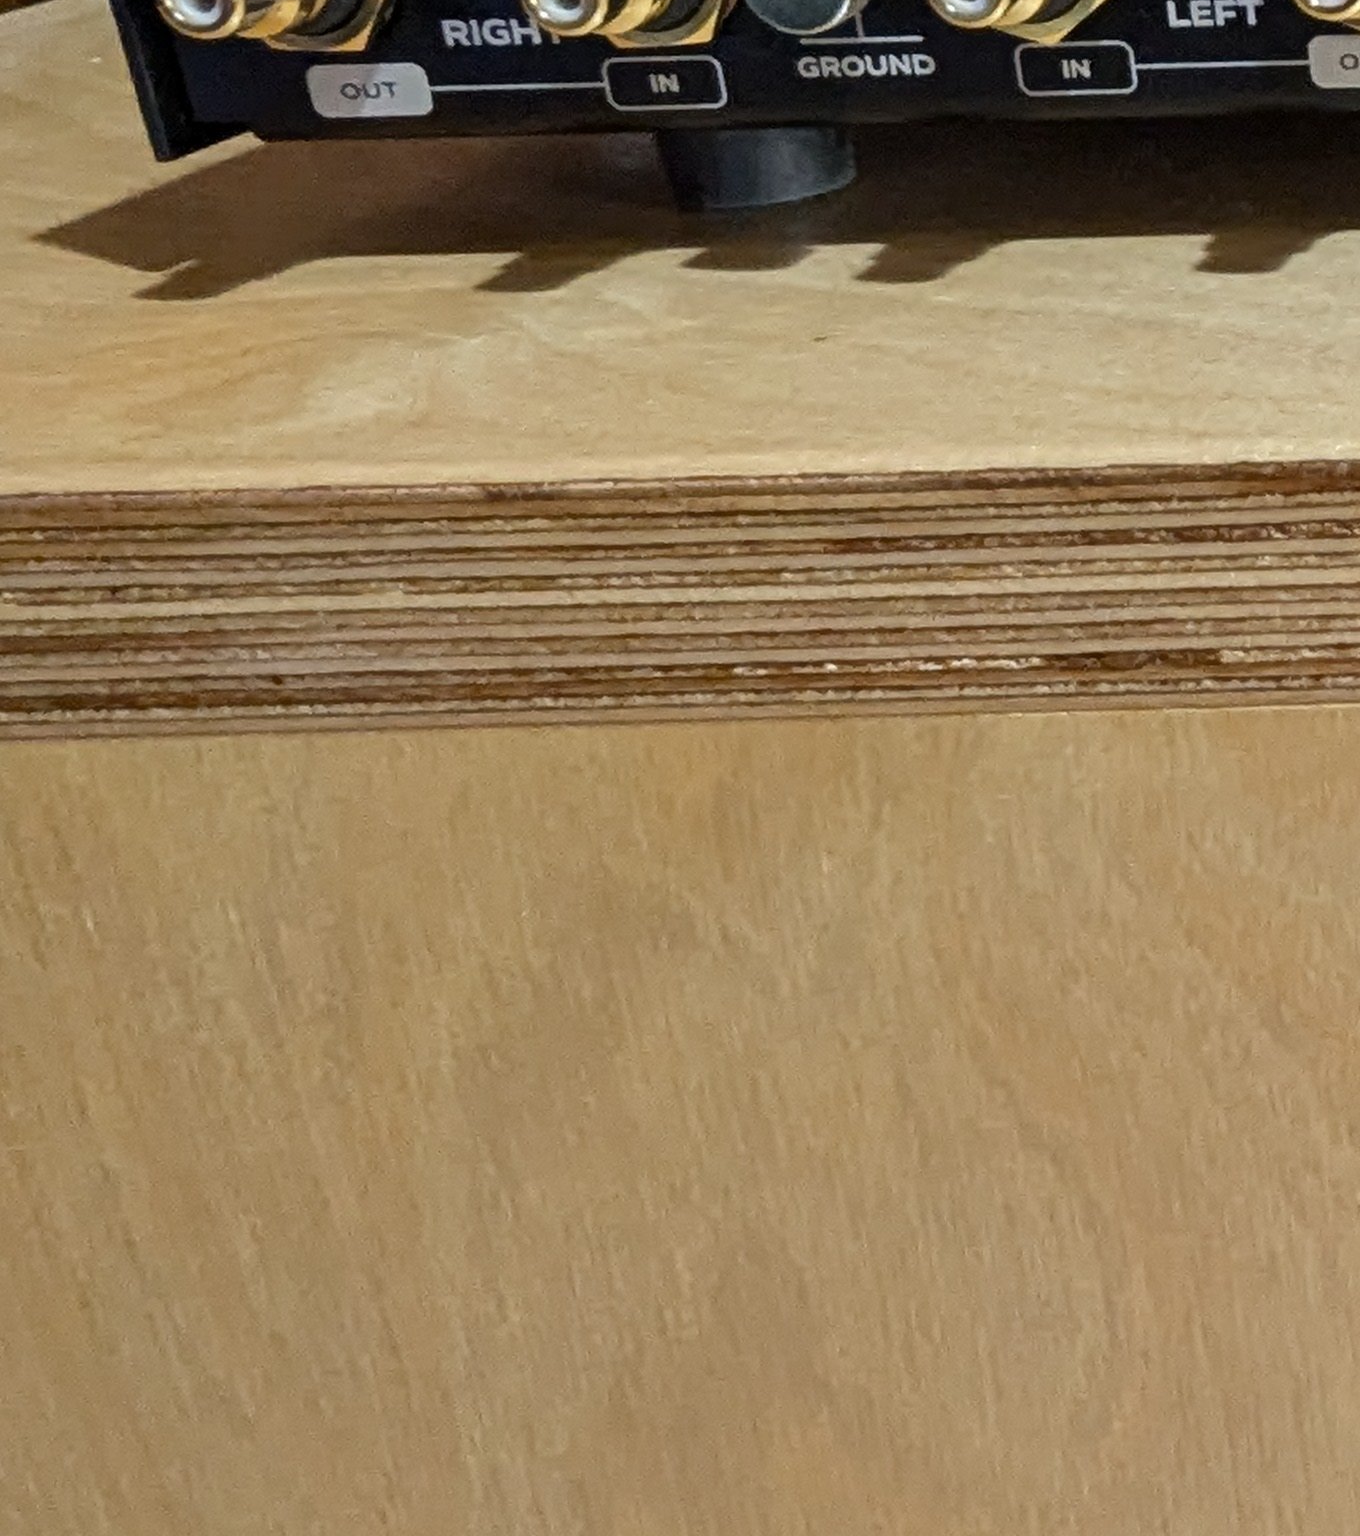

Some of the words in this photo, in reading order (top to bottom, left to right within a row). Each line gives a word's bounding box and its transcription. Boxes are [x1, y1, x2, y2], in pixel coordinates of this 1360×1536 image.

[1167, 0, 1264, 29] LEFT
[440, 18, 561, 48] RIGH
[796, 54, 936, 78] GROUND
[1060, 58, 1091, 80] IN
[340, 81, 396, 101] OUT
[649, 73, 680, 94] IN
